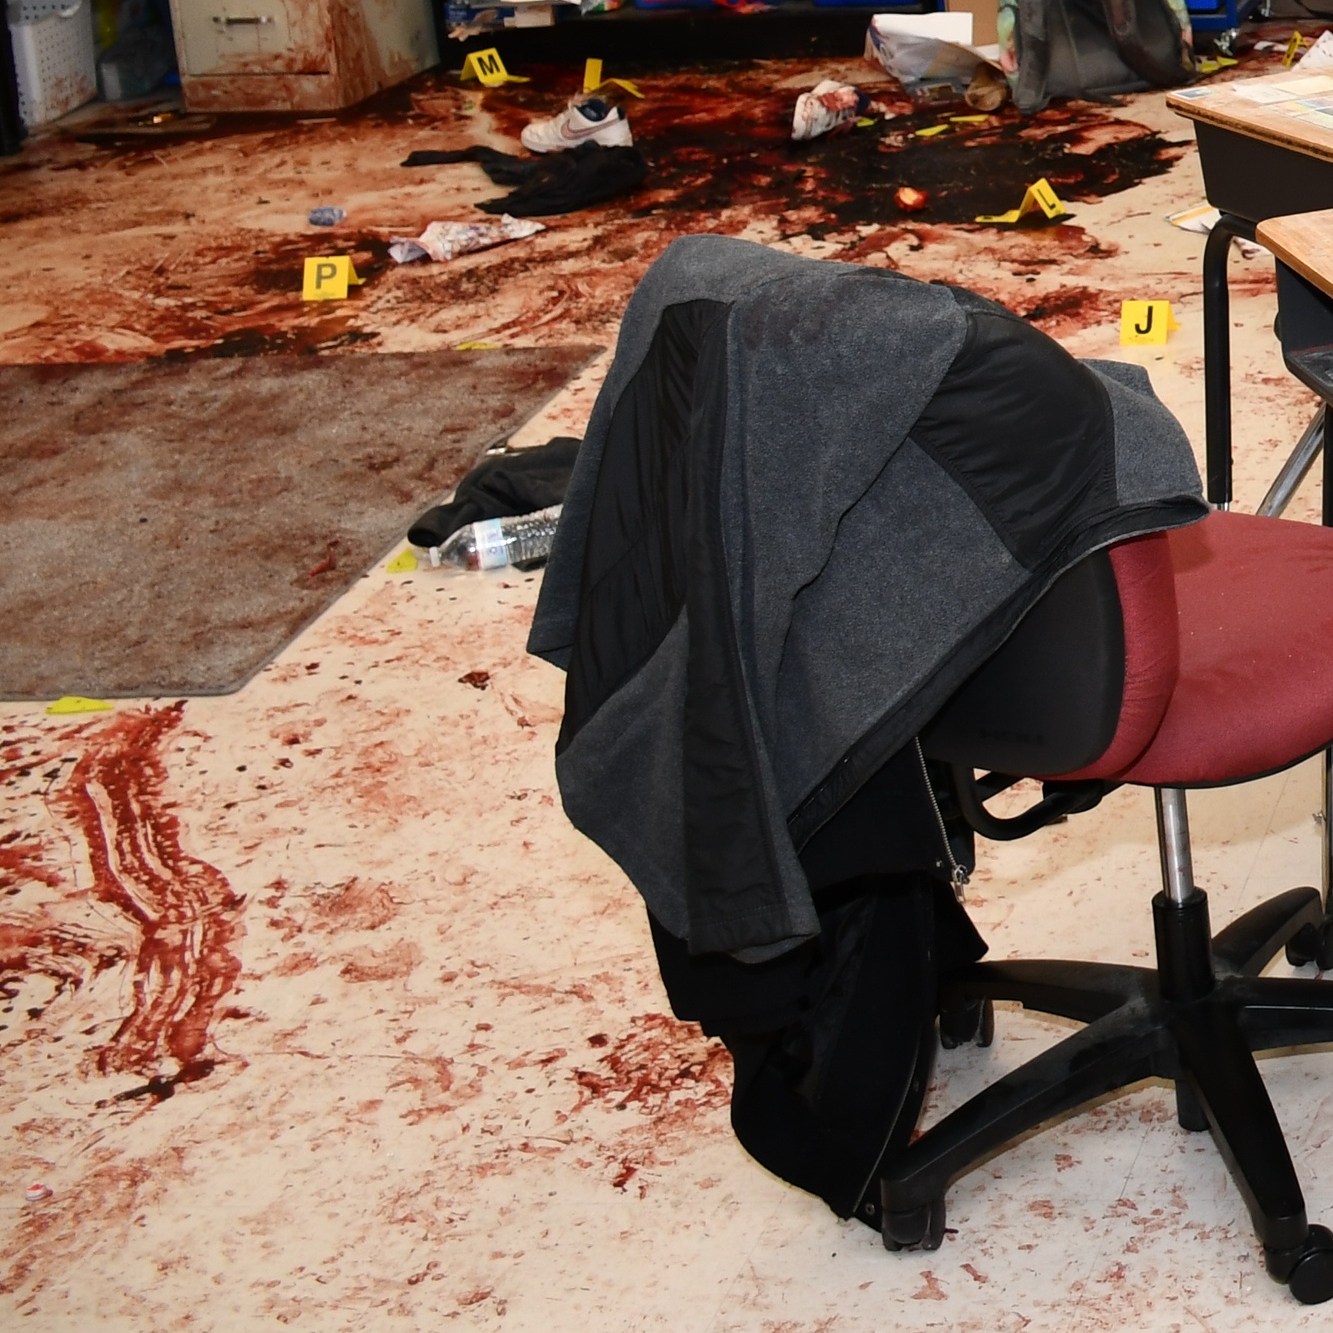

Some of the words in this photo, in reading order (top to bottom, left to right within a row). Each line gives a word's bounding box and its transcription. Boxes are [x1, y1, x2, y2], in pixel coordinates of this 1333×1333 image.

[477, 54, 501, 77] M
[315, 262, 338, 290] P
[1135, 306, 1154, 335] J
